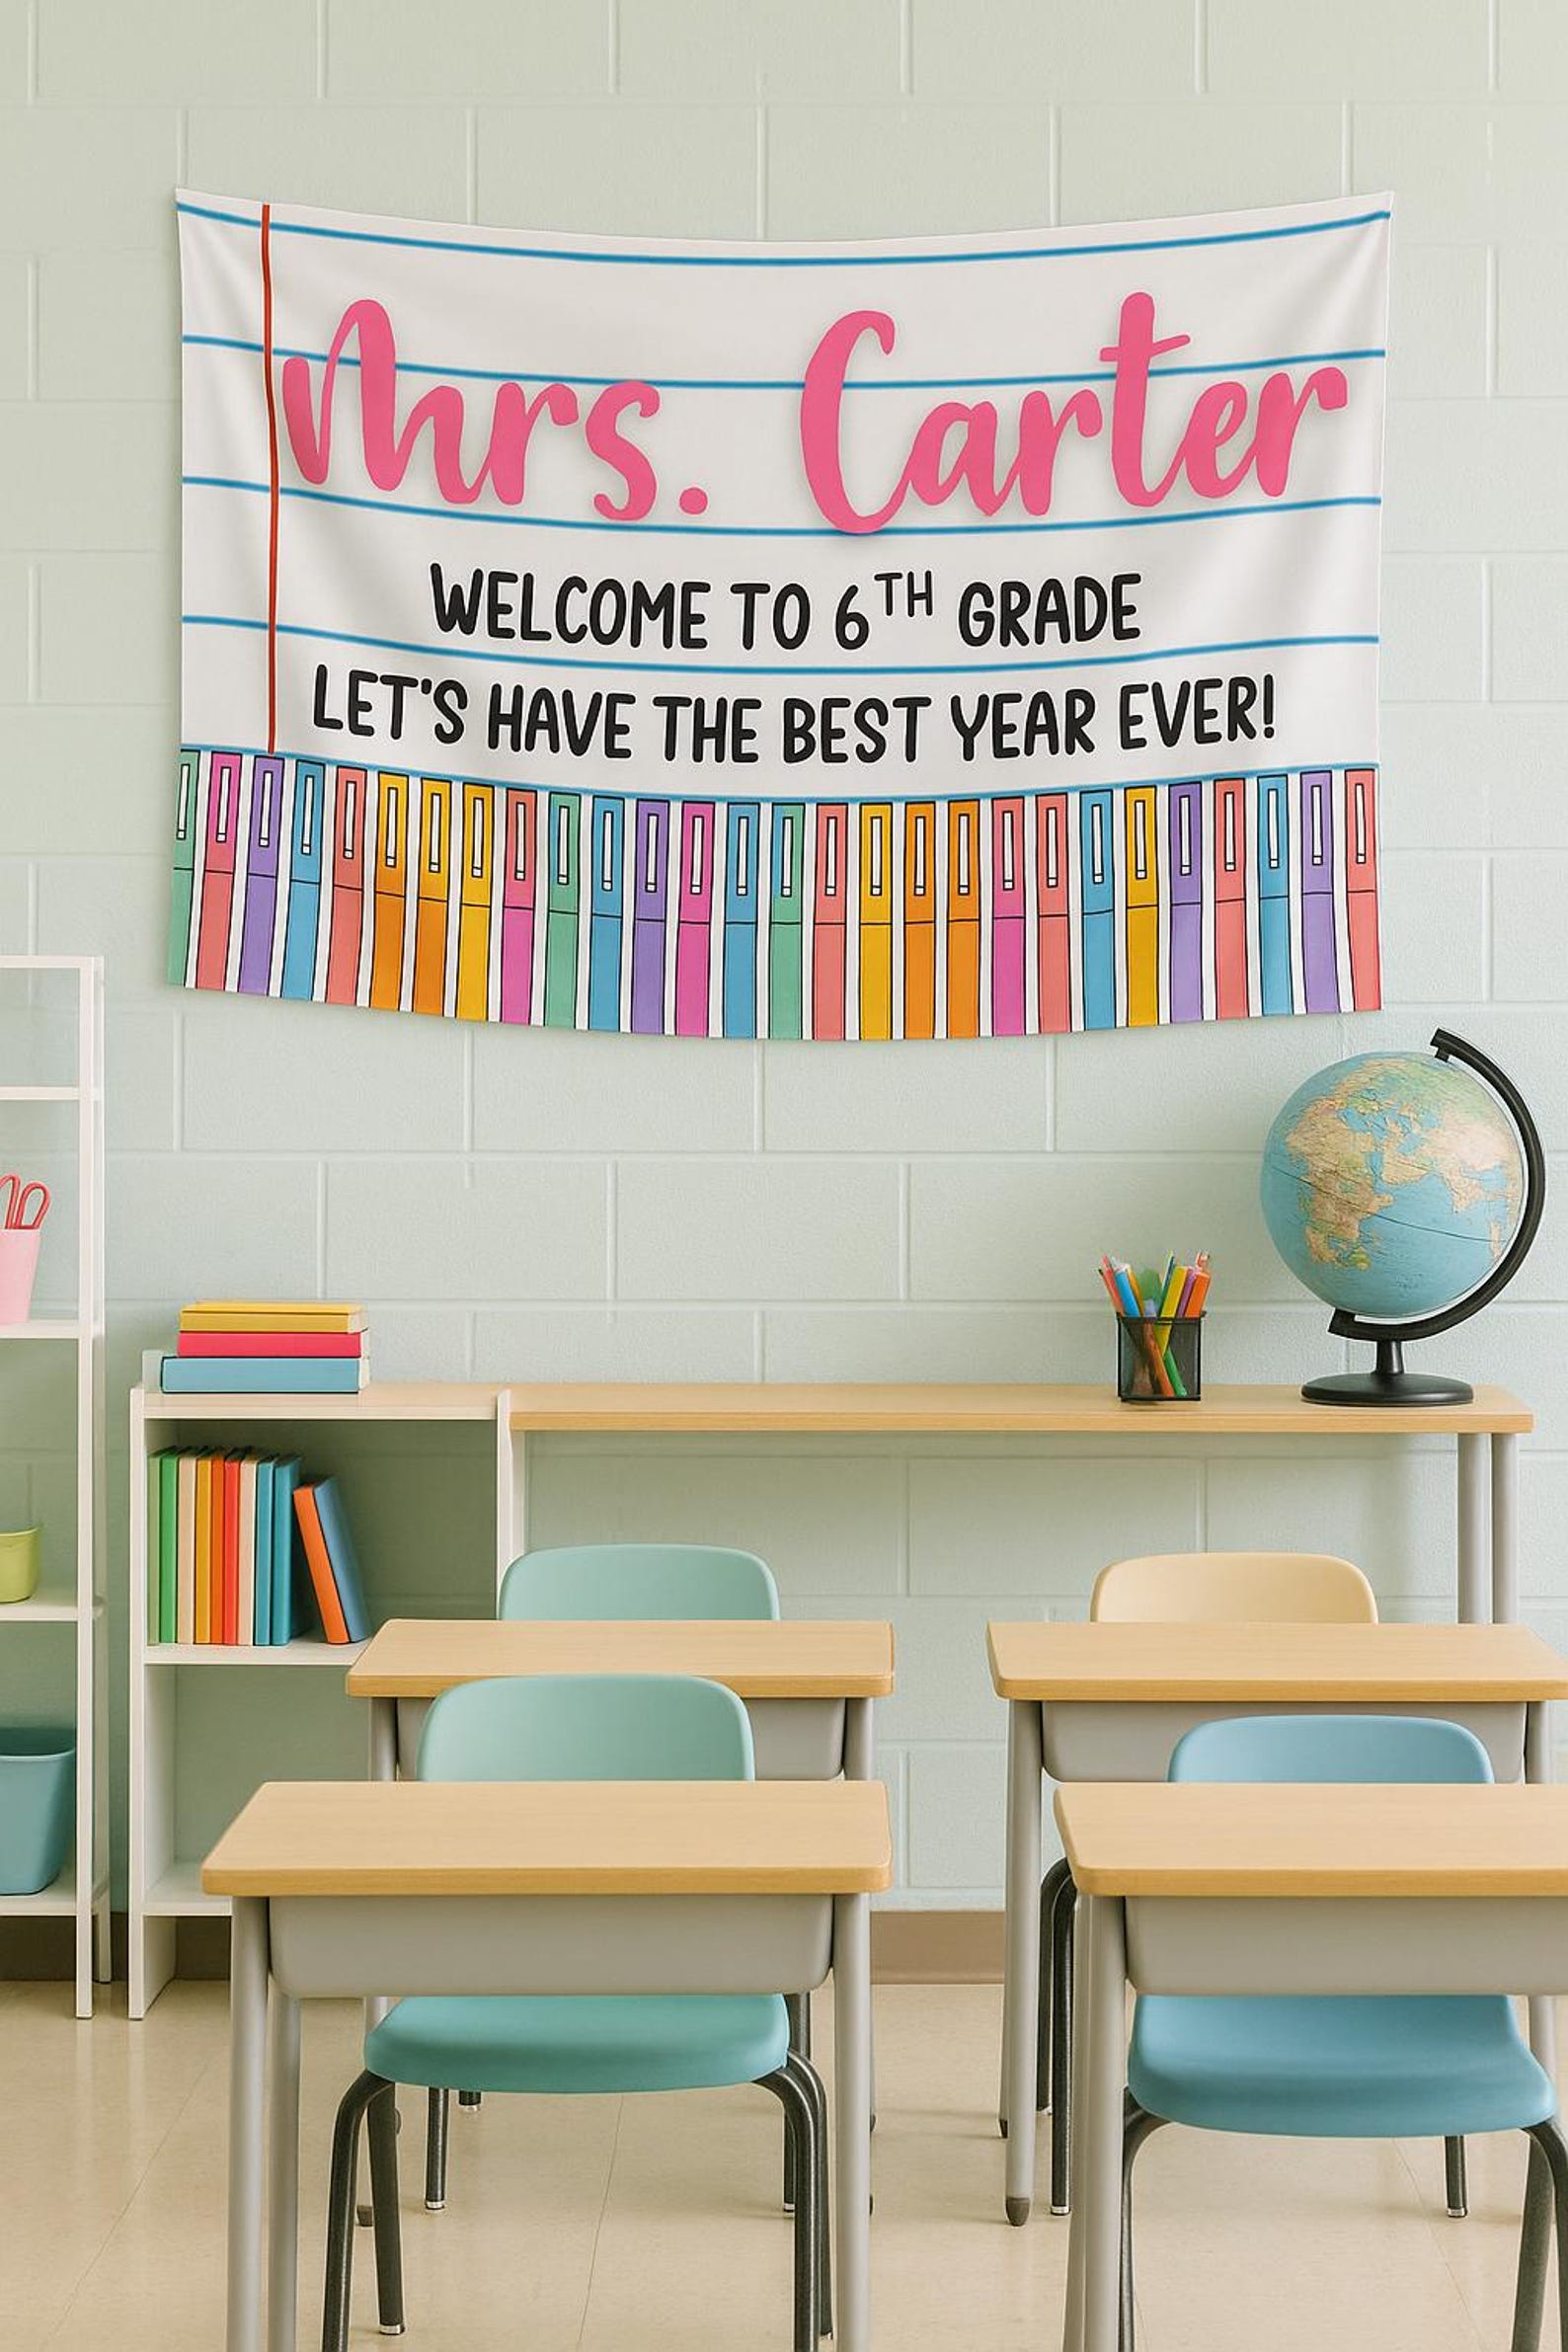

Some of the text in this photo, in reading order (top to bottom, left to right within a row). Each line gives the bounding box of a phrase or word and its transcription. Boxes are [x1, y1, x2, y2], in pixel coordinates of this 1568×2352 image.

[282, 291, 1349, 534] Mrs. Carter
[429, 562, 1142, 652] WELCOME TO 6TH GRADE
[312, 663, 1276, 765] LET'S HAVE THE BEST YEAR EVER!
